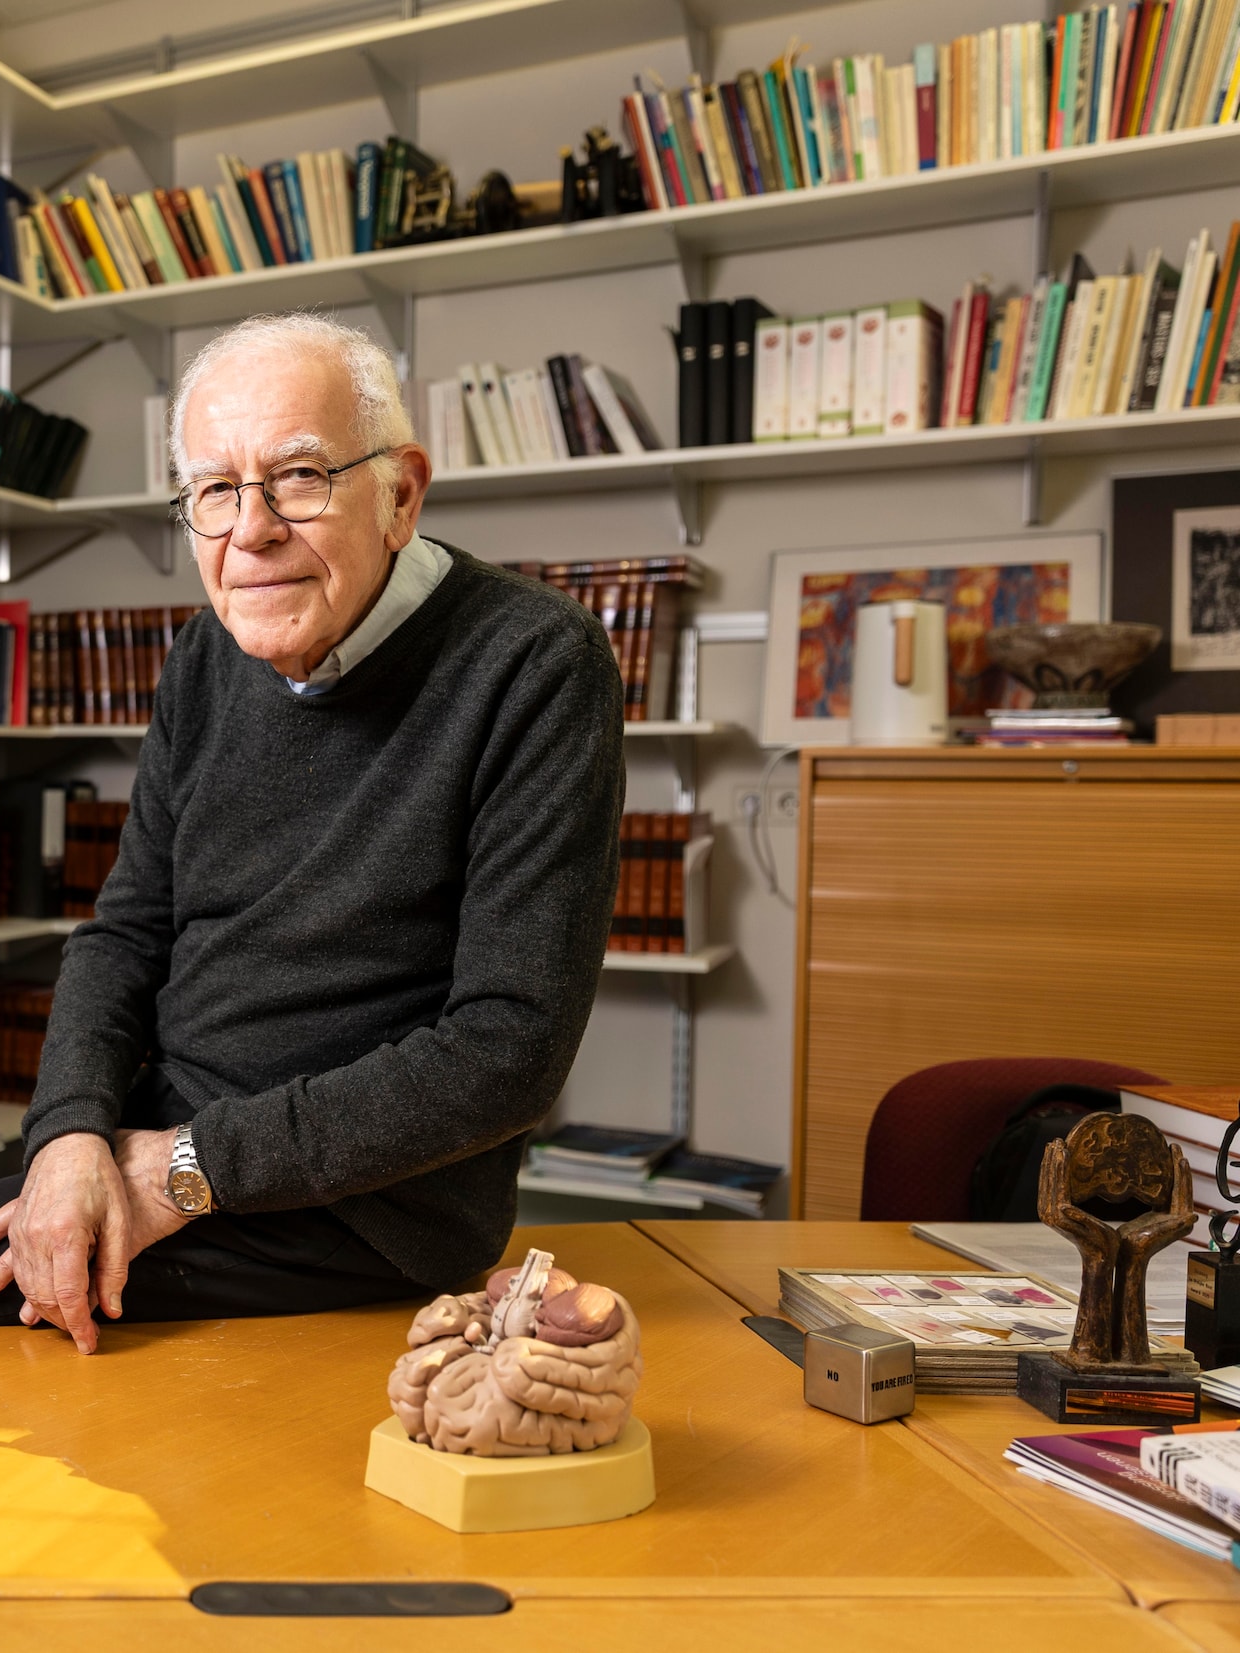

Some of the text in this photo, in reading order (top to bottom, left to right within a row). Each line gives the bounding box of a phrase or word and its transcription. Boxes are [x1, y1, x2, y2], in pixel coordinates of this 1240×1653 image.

[827, 1369, 839, 1382] NO
[871, 1374, 914, 1392] YOU ARE FIRED
